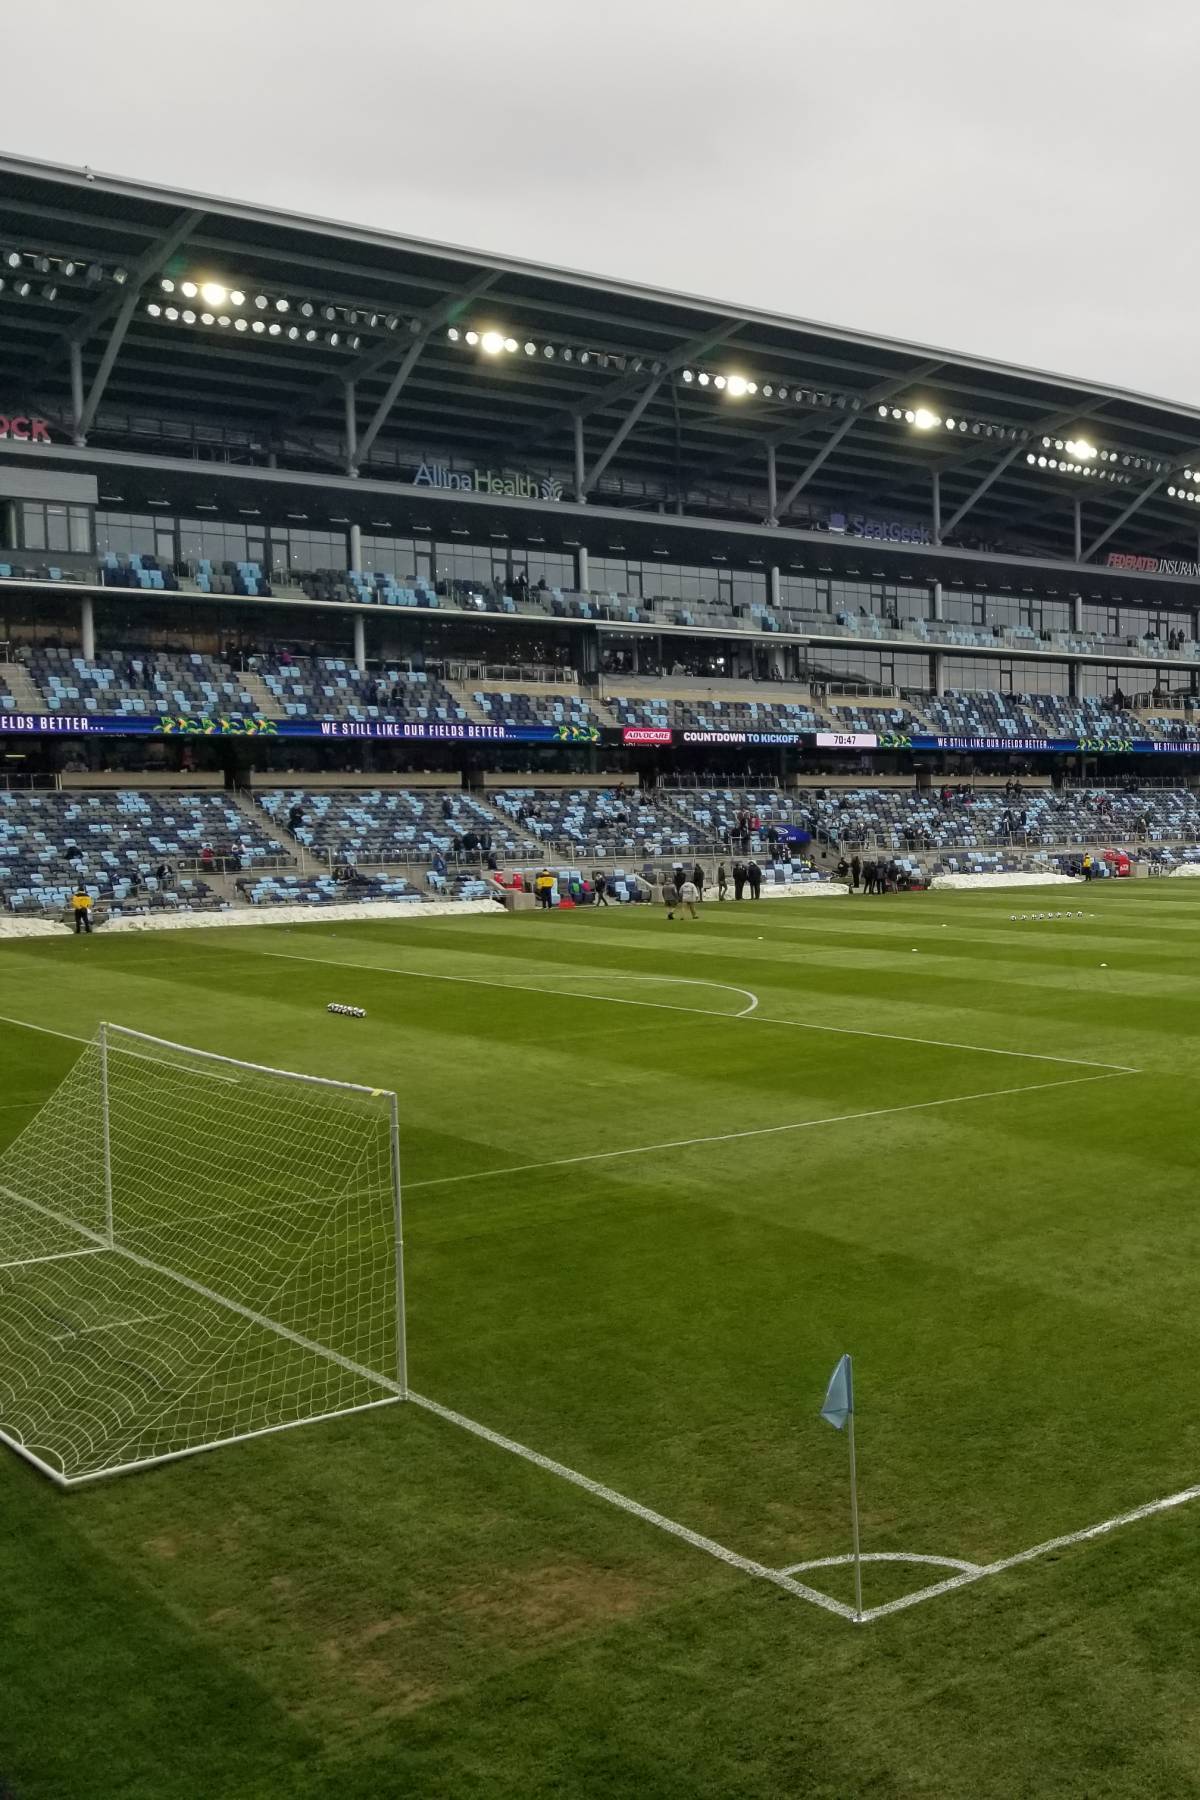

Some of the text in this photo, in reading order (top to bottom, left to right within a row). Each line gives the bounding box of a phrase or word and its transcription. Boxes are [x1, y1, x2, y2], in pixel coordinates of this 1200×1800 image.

[413, 463, 539, 499] Allina Health
[853, 517, 930, 545] SeatGeek
[1107, 553, 1159, 573] FEDERATED
[321, 722, 337, 735] WE
[342, 723, 372, 735] STILL
[376, 724, 400, 736] LIKE
[404, 725, 425, 736] OUR
[429, 725, 464, 737] FIELDS
[625, 731, 671, 740] ADVOCARE
[683, 732, 799, 744] COUNTDOWN TO KICKOFF
[834, 735, 857, 745] 70:47
[938, 738, 948, 747] WE
[950, 738, 968, 748] STILL
[970, 739, 984, 748] LIKE
[986, 739, 999, 748] OUR
[1001, 739, 1023, 749] FIELDS
[1153, 742, 1161, 751] WE
